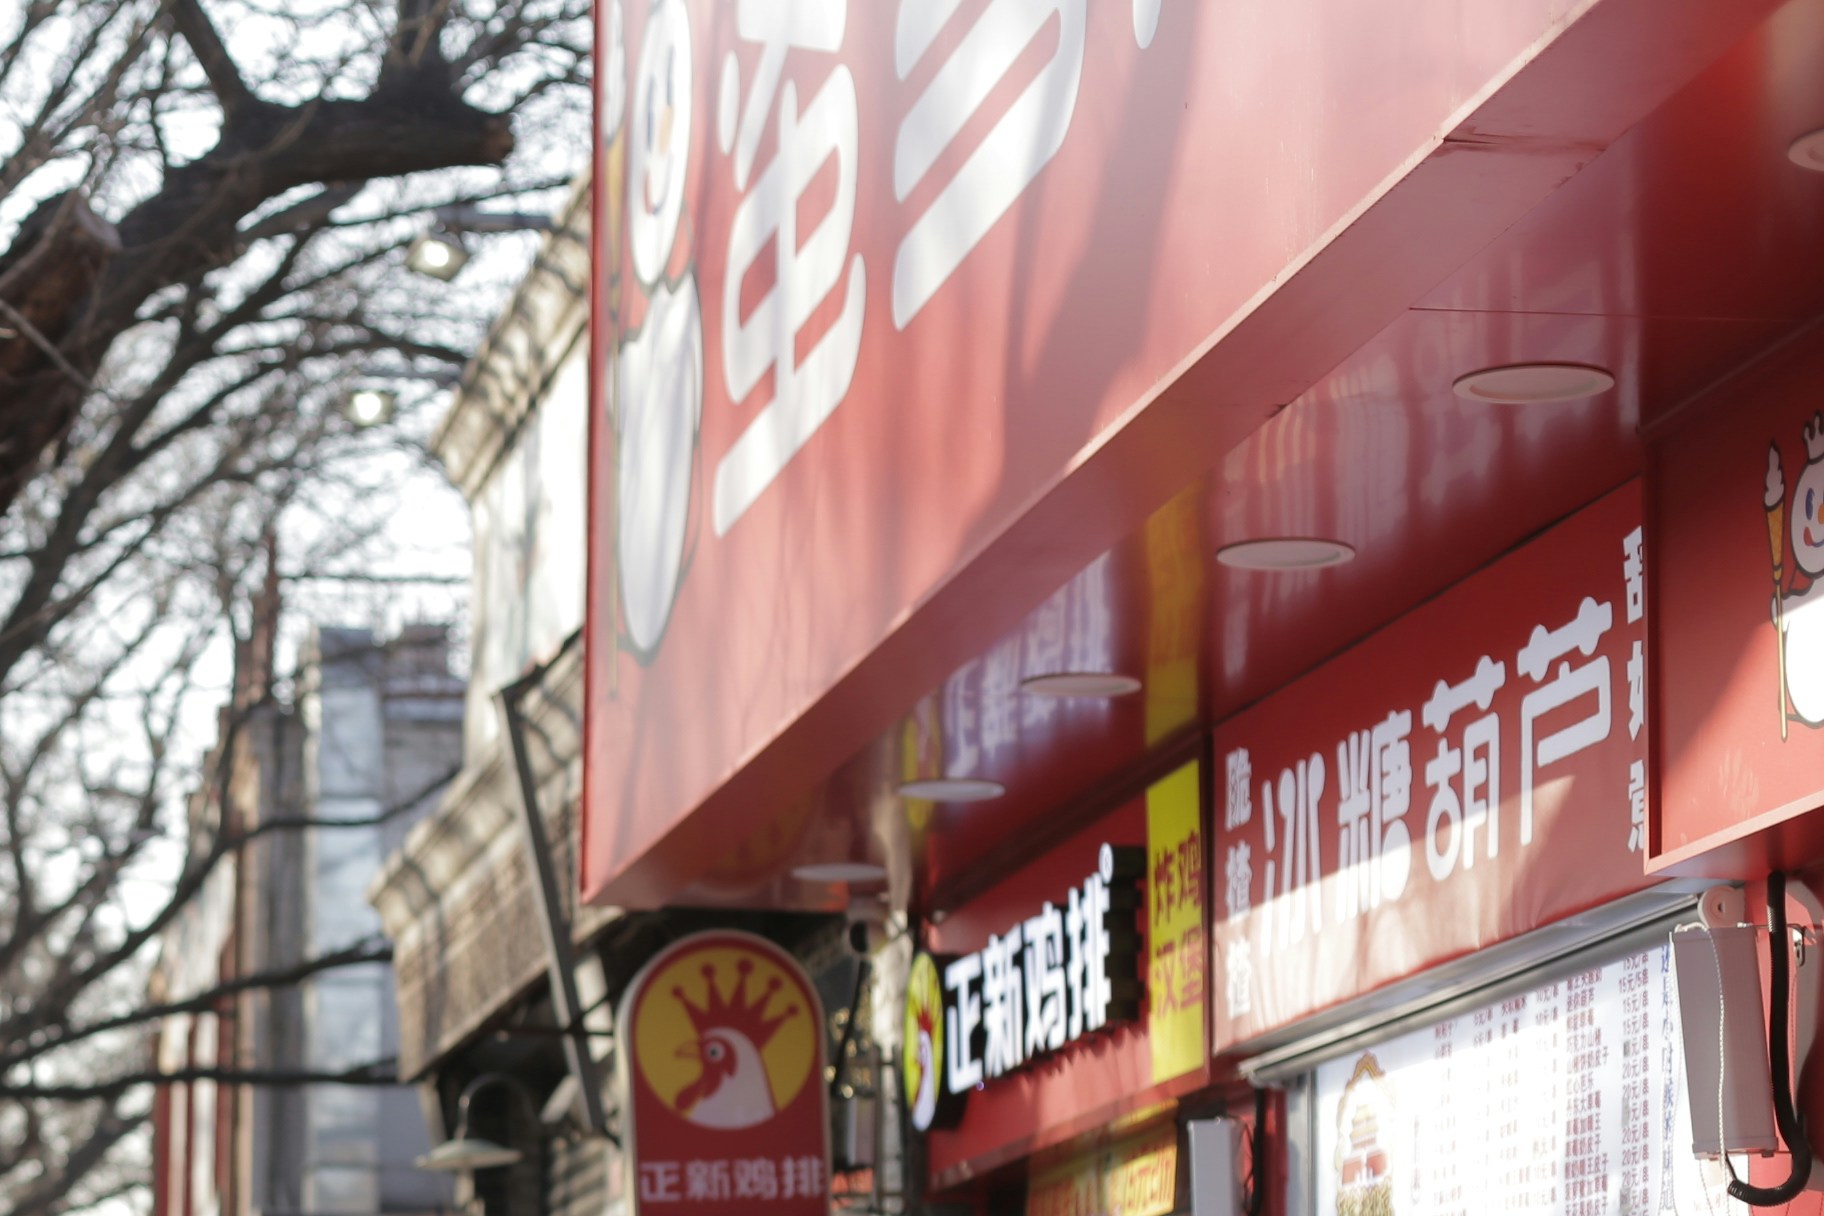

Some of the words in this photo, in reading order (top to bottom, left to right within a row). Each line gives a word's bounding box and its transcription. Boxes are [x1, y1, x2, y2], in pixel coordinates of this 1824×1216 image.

[1259, 596, 1613, 956] 冰糖葫芦
[1153, 830, 1203, 928] 炸鸡
[945, 871, 1111, 1095] 正新鸡排
[1153, 928, 1204, 1018] 汉堡
[640, 1155, 826, 1205] 正新鸡排
